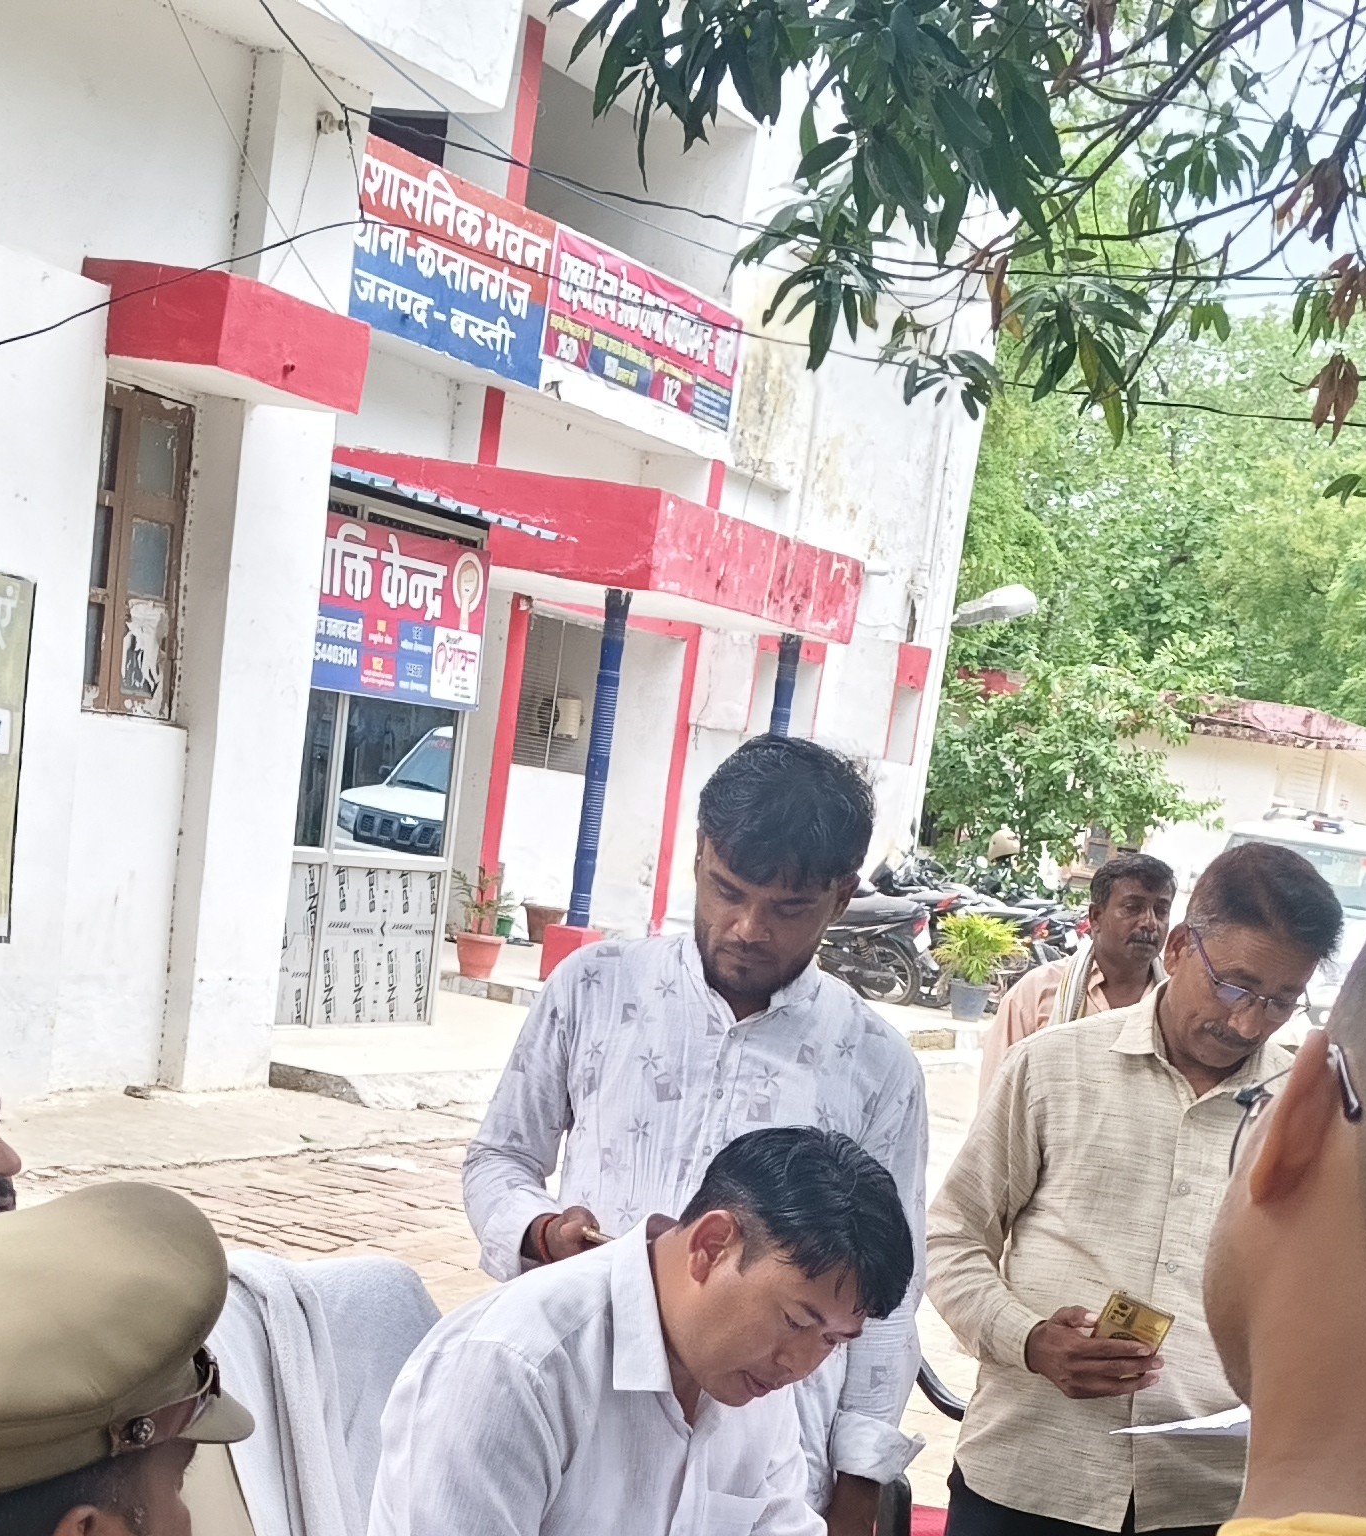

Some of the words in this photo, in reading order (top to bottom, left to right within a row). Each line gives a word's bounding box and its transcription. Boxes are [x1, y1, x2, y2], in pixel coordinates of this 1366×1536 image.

[486, 212, 551, 278] भवन
[354, 267, 435, 329] जनपद
[450, 307, 516, 355] बस्ती
[662, 376, 681, 406] 112
[380, 533, 448, 621] केन्द्र
